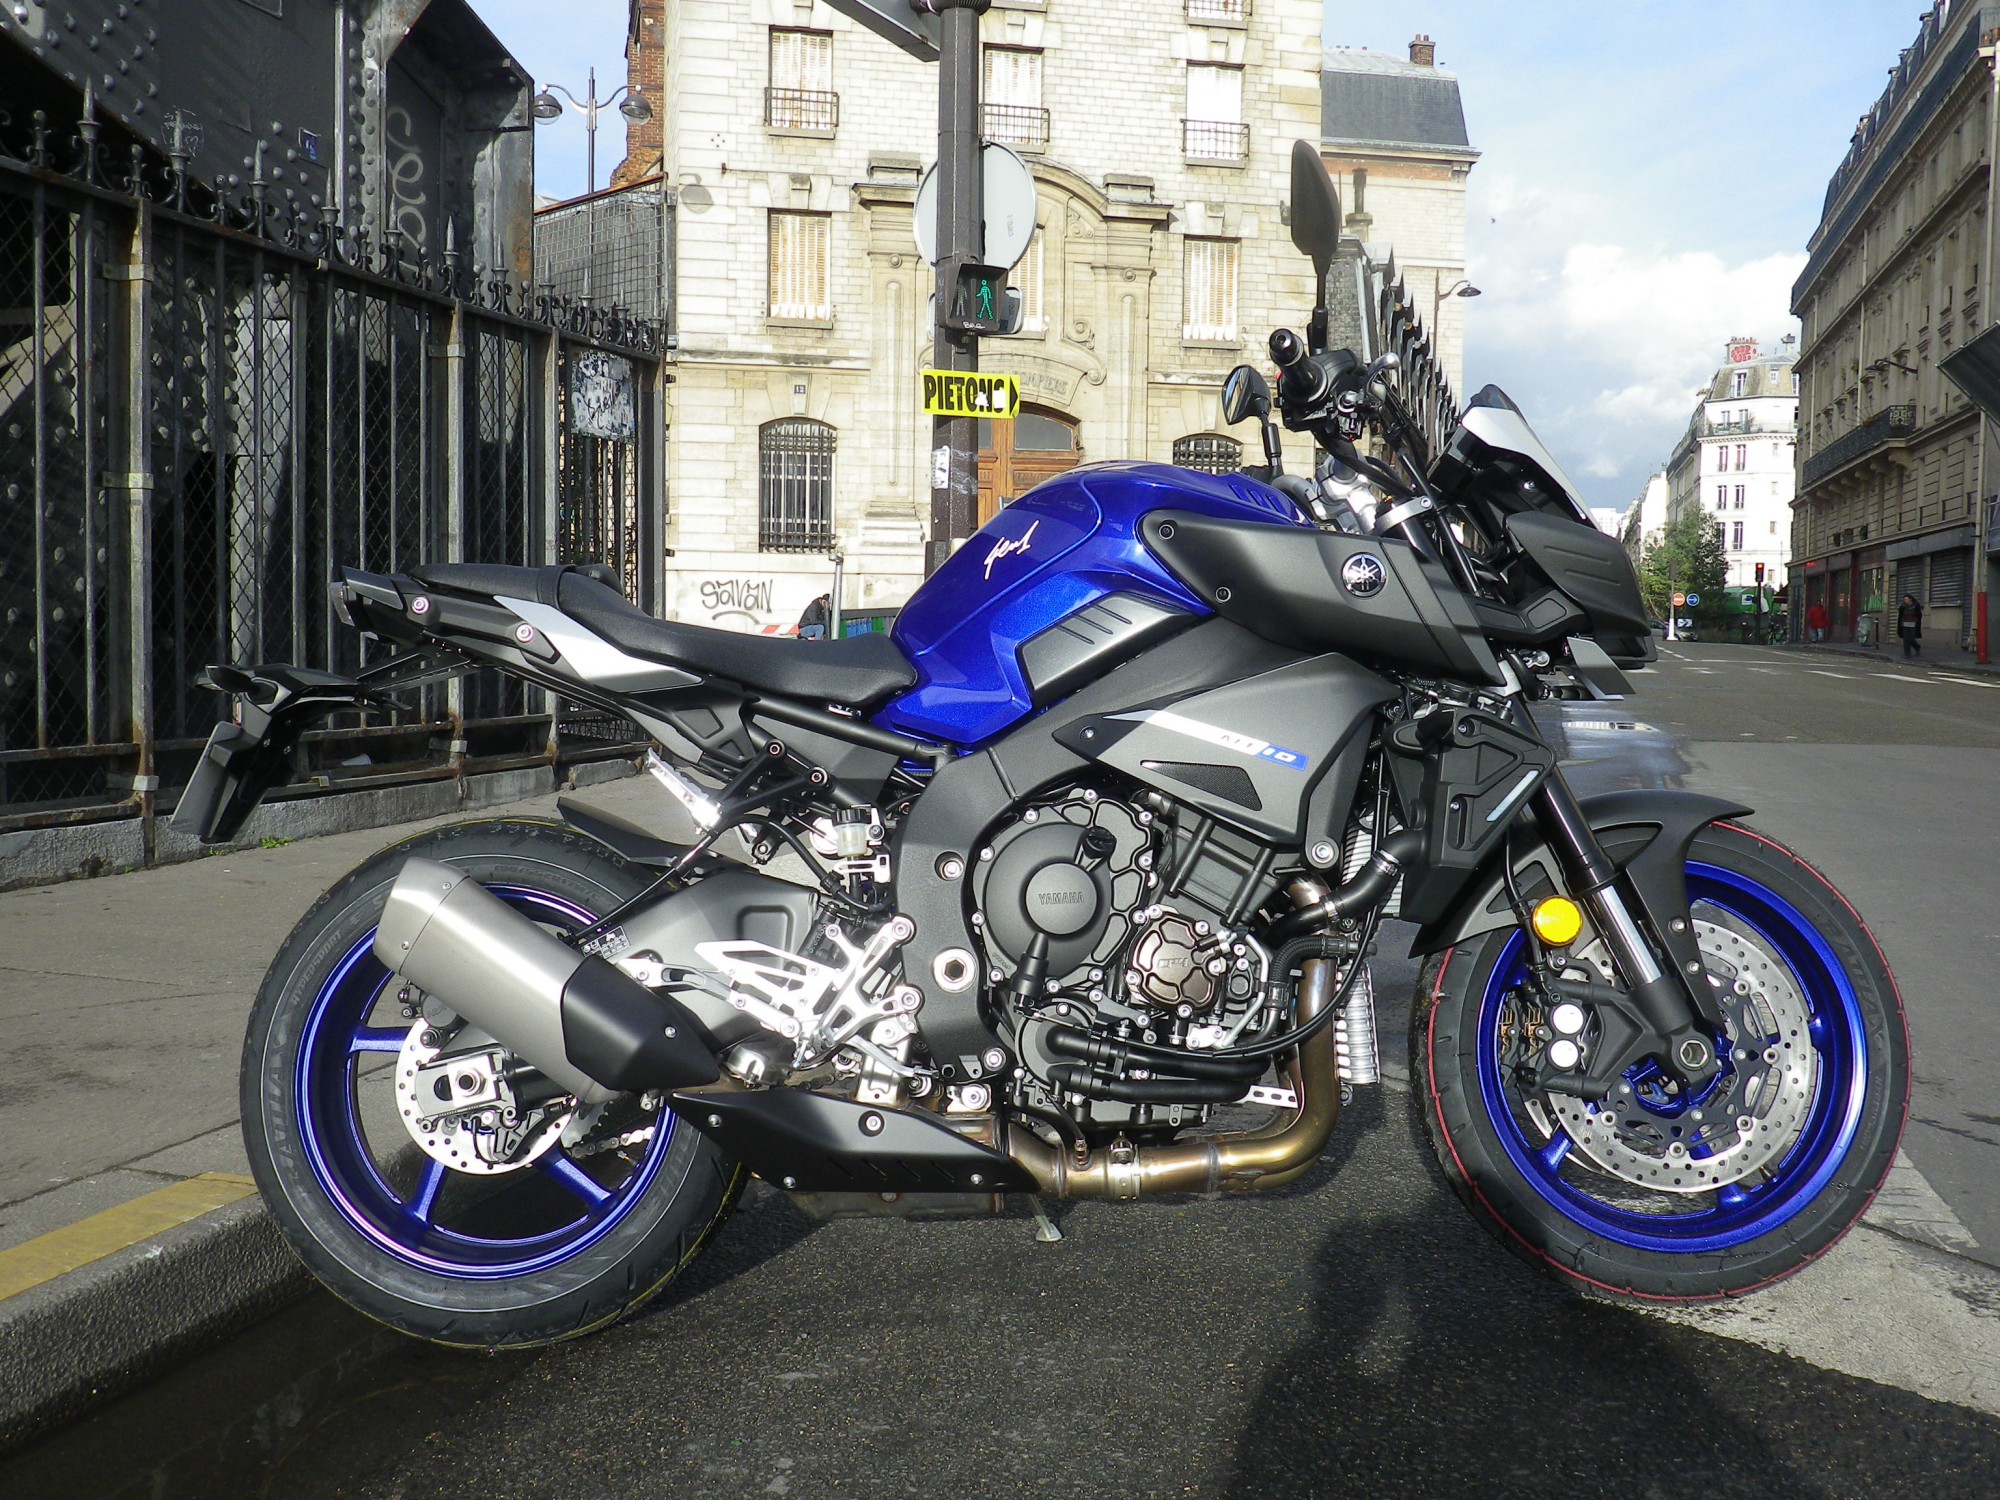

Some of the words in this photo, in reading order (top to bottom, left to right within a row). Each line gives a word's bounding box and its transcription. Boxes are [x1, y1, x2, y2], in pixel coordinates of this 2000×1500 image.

[1012, 370, 1068, 395] OMPIERS
[1038, 891, 1086, 905] YAMAHA
[290, 928, 343, 1005] HYPERSPORT
